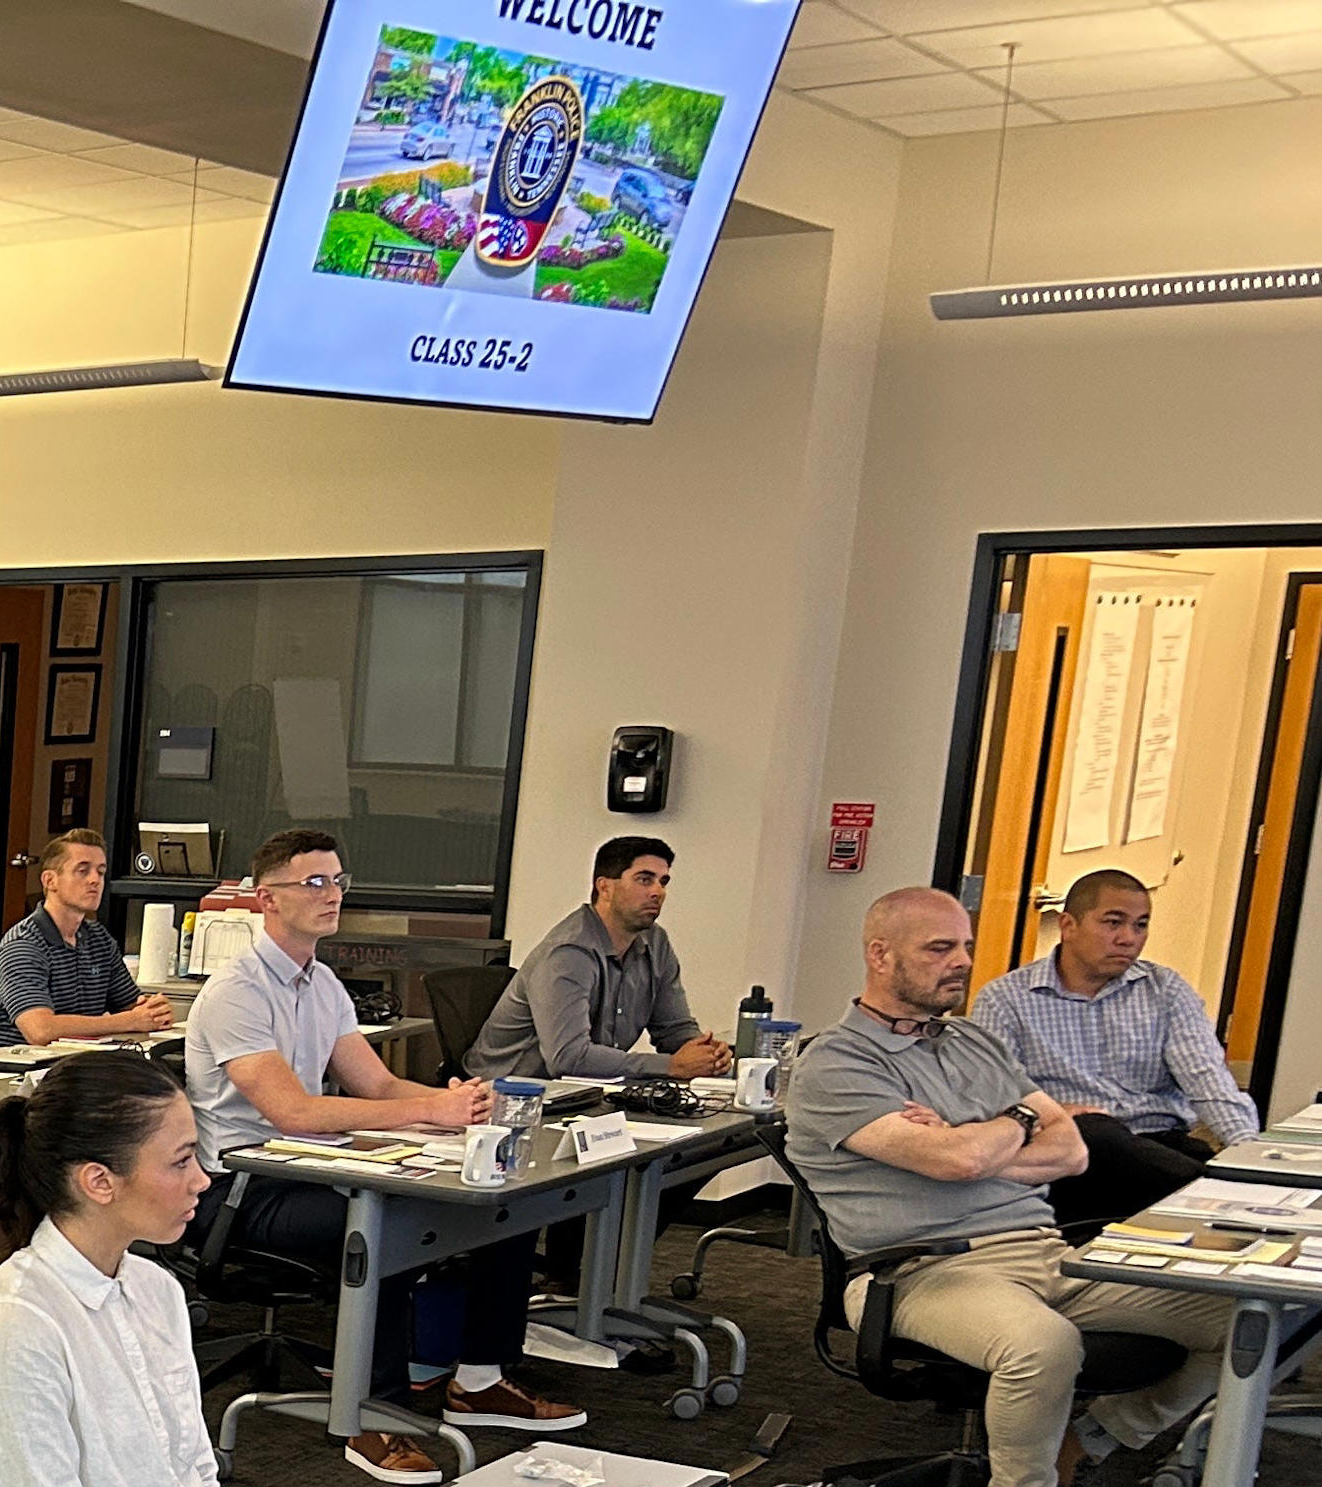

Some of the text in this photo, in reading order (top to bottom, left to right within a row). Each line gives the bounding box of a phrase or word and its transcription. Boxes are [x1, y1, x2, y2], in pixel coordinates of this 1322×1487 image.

[499, 0, 663, 50] WELCOME
[410, 334, 534, 372] CLASS 25-2
[833, 830, 861, 840] FIRE
